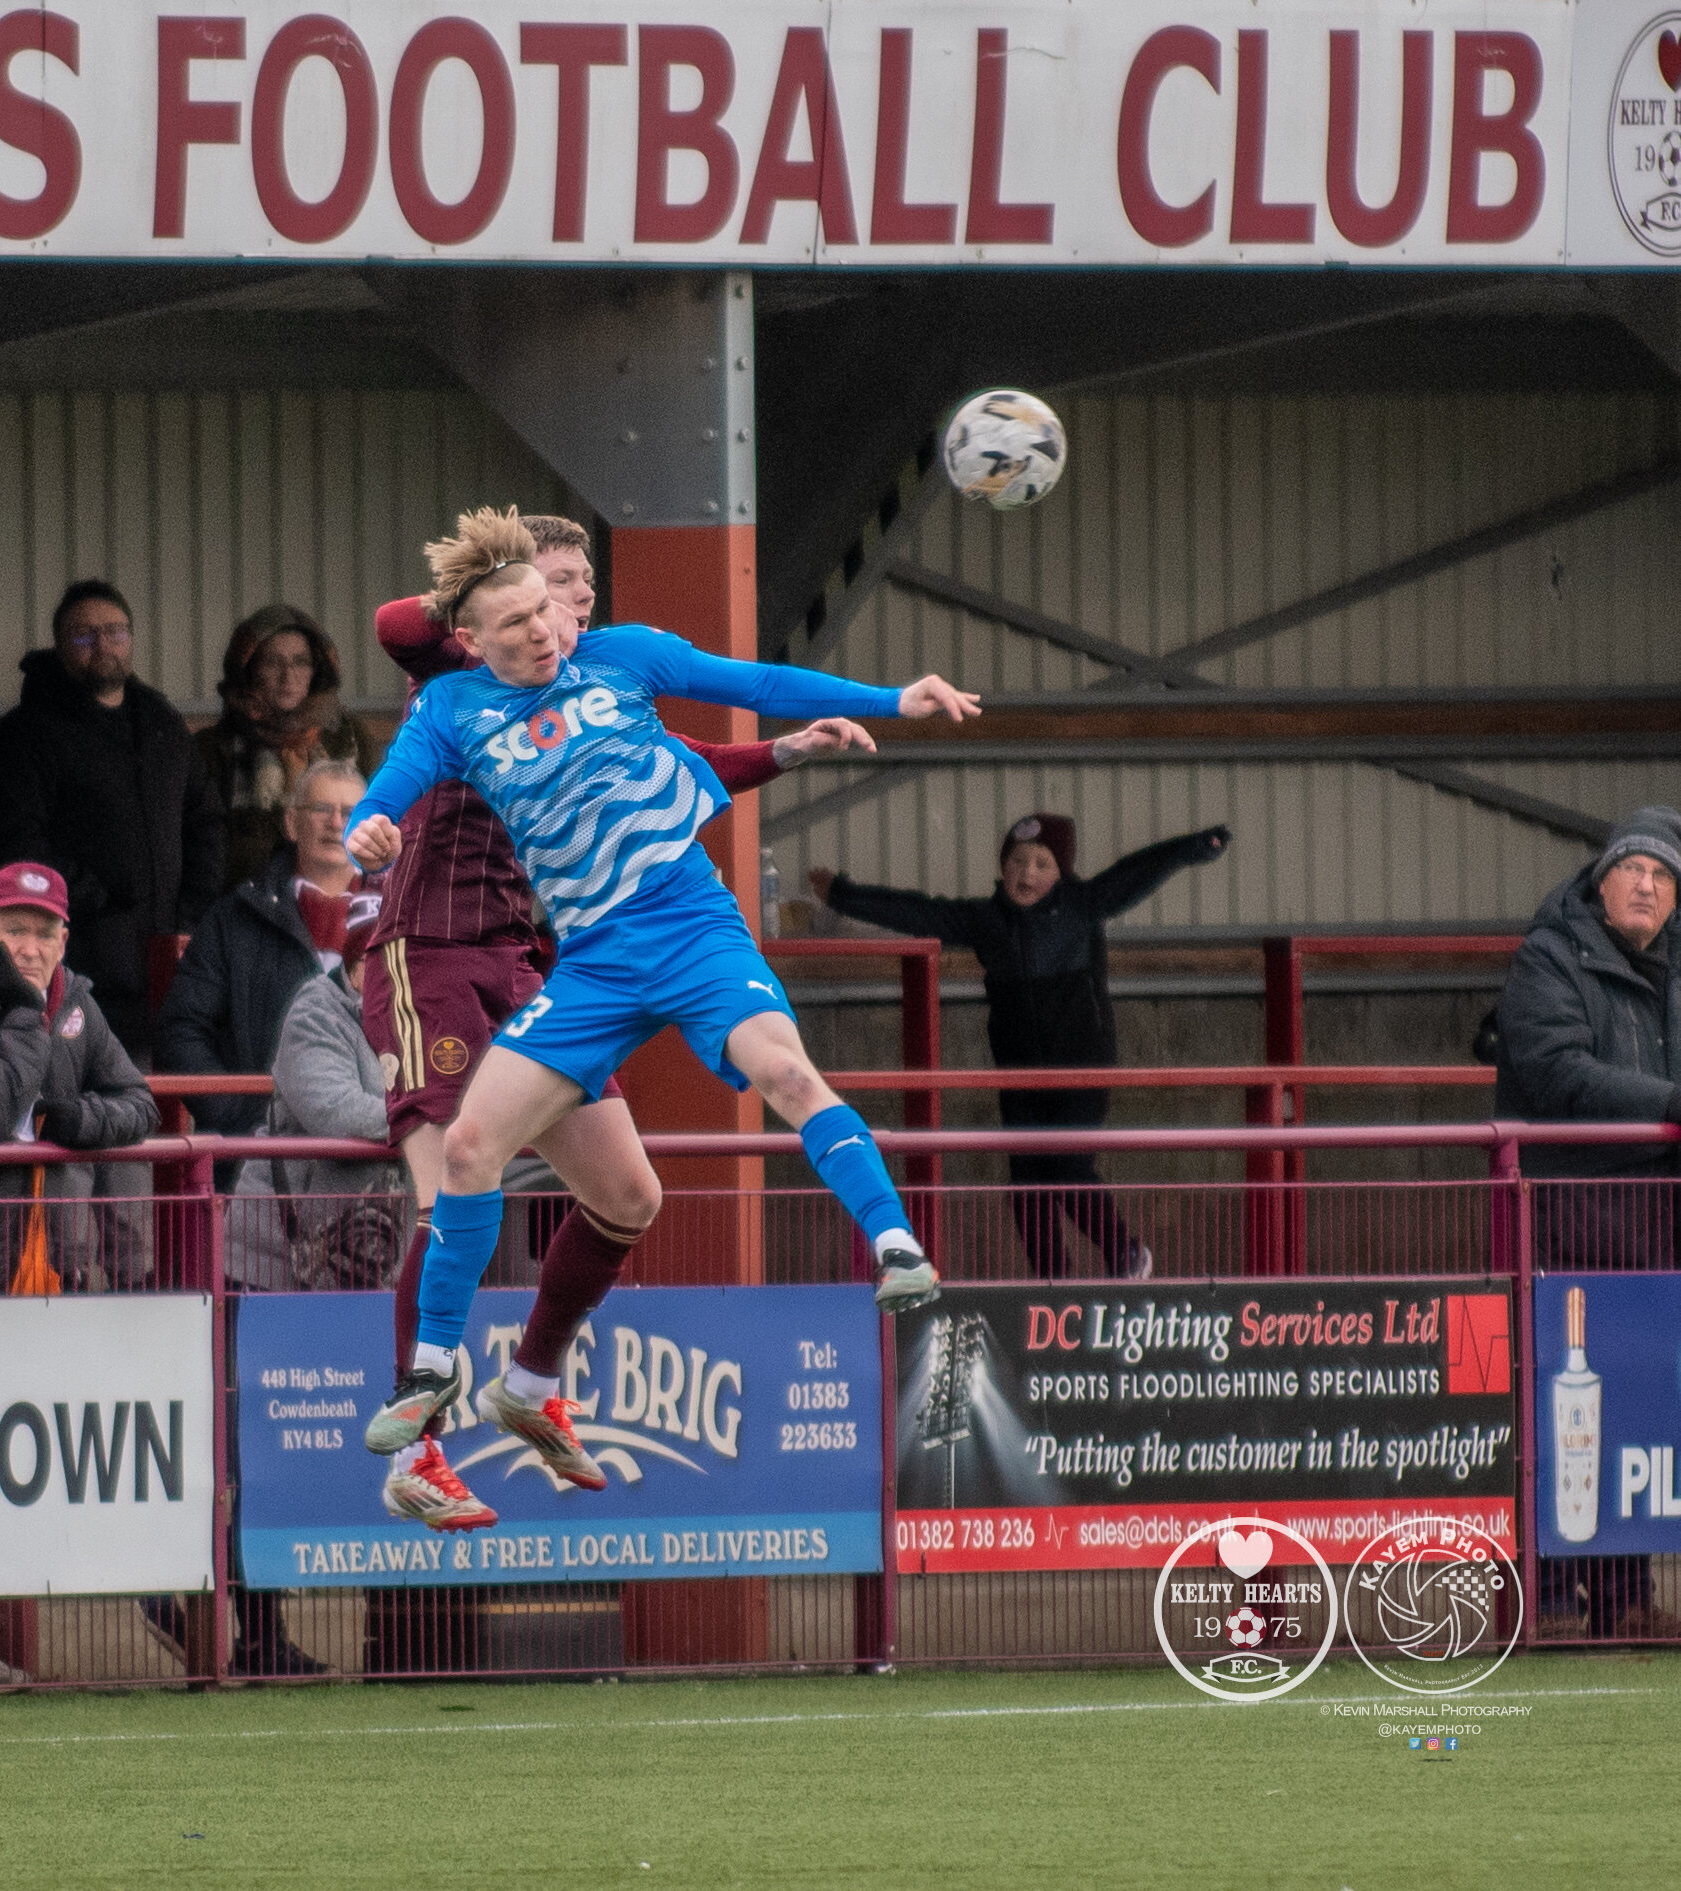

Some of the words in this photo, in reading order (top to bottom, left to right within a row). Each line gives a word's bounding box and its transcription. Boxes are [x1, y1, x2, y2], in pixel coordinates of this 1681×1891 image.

[1621, 100, 1667, 125] KELTY
[152, 14, 1056, 245] FOOTBALL
[1117, 24, 1547, 248] CLUB
[1635, 145, 1655, 171] 19
[487, 687, 620, 774] score
[1027, 1305, 1083, 1351] DC
[1092, 1300, 1233, 1363] Lighting
[1240, 1300, 1373, 1347] Services
[1383, 1298, 1440, 1344] Ltd
[799, 1341, 837, 1369] Tel:
[262, 1368, 287, 1388] 448
[290, 1367, 321, 1391] High
[324, 1367, 365, 1387] Street
[611, 1326, 742, 1458] BRIG
[1029, 1374, 1109, 1401] SPORTS
[1120, 1370, 1299, 1399] FLOODLIGHTING
[1310, 1368, 1440, 1396] SPECIALISTS
[268, 1399, 357, 1419] Cowdenbeath
[788, 1382, 850, 1410] 01383
[283, 1429, 312, 1450] KY4
[315, 1428, 344, 1449] 8LS
[781, 1422, 857, 1451] 223633
[1142, 1432, 1180, 1473] the
[1188, 1437, 1302, 1473] customer
[1308, 1430, 1333, 1469] in
[1340, 1427, 1379, 1469] the
[897, 1519, 955, 1550] 01382
[961, 1519, 995, 1549] 738
[1001, 1518, 1035, 1548] 236
[293, 1539, 444, 1575] TAKEAWAY
[453, 1538, 472, 1570] &
[481, 1536, 555, 1569] FREE
[563, 1533, 654, 1566] LOCAL
[663, 1528, 829, 1563] DELIVERIES
